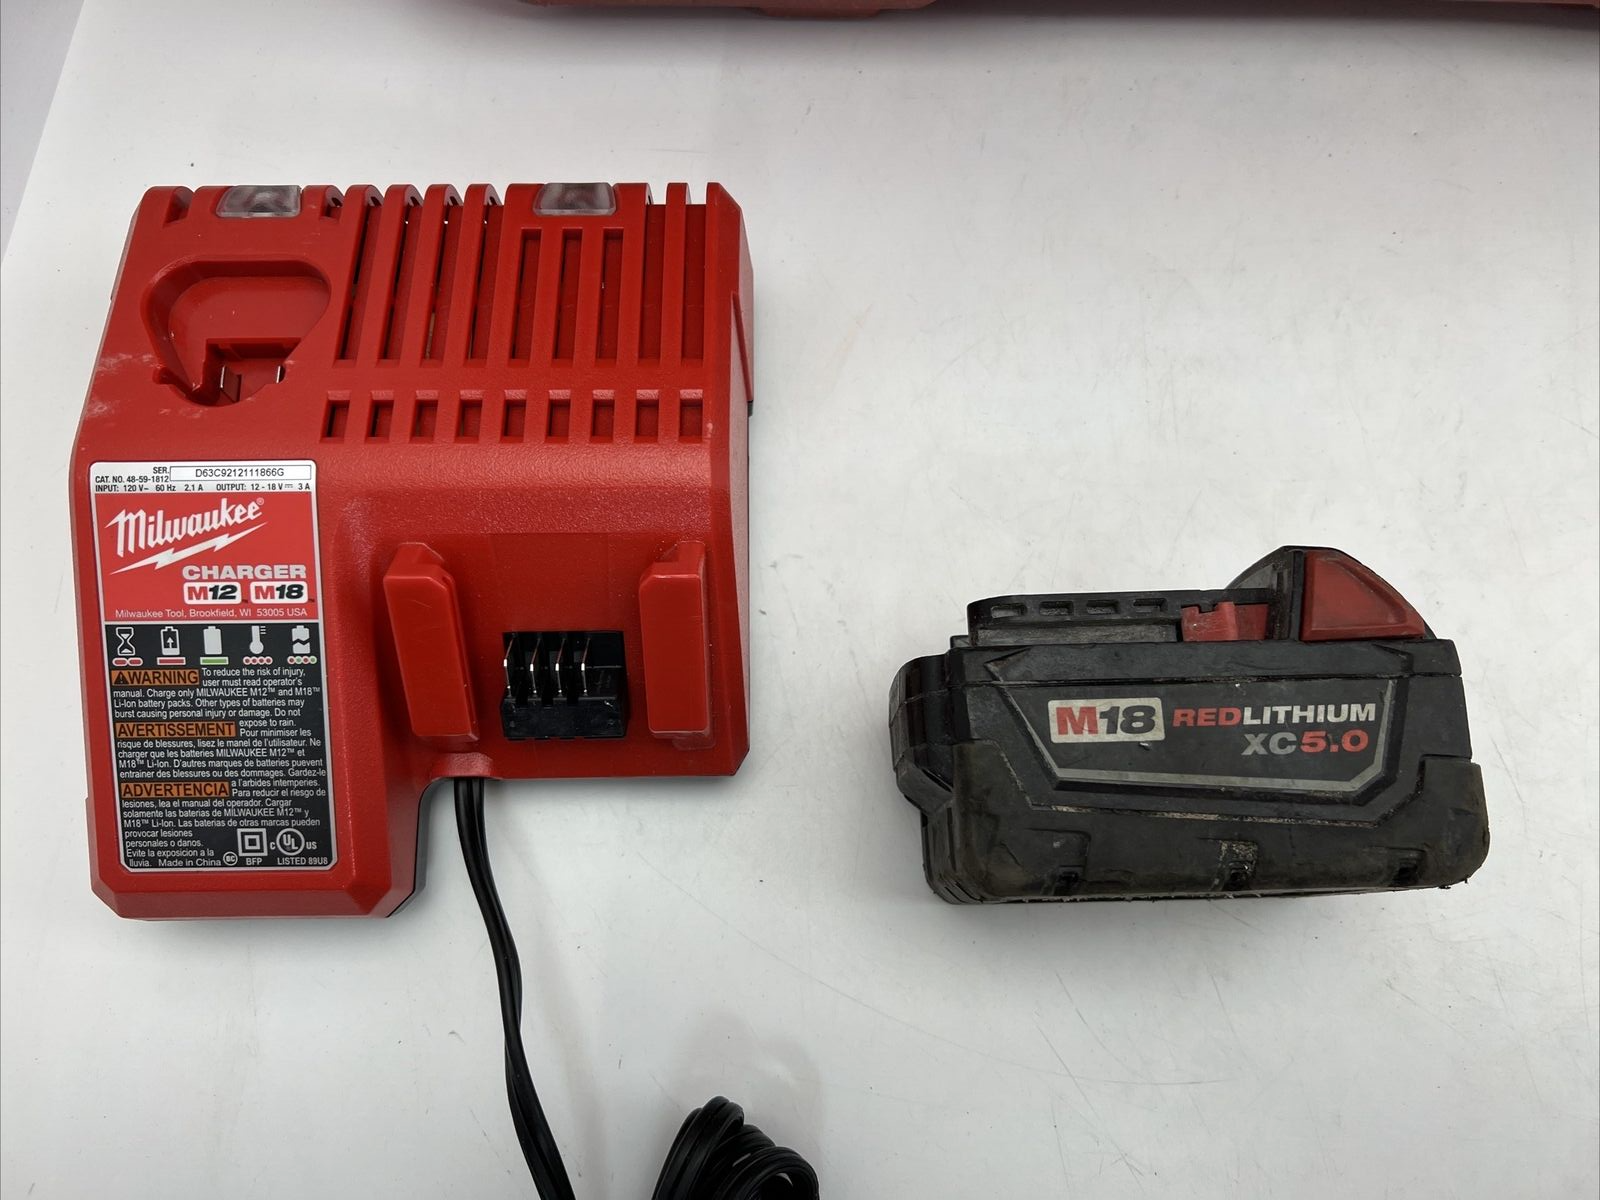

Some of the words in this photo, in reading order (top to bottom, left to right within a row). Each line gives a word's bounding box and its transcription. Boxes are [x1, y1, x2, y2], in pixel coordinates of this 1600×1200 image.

[182, 564, 306, 580] CHARGER
[164, 610, 187, 618] Tool,
[189, 608, 238, 618] Brookfield,
[240, 608, 252, 616] WI
[287, 608, 308, 616] USA
[128, 670, 198, 684] WARNING
[202, 668, 212, 676] To
[214, 668, 240, 676] reduce
[242, 668, 254, 676] the
[257, 668, 271, 676] risk
[273, 667, 280, 676] of
[282, 668, 306, 677] injury,
[243, 678, 261, 686] read
[113, 688, 144, 698] manual.
[146, 688, 176, 699] Charge
[178, 688, 194, 698] only
[196, 688, 248, 697] MILWAUKEE
[278, 688, 292, 696] and
[114, 699, 136, 708] Li-Ion
[138, 699, 166, 709] battery
[168, 698, 193, 709] packs.
[195, 698, 218, 707] Other
[220, 698, 240, 708] types
[242, 698, 251, 706] of
[252, 698, 286, 706] batteries
[288, 699, 304, 708] may
[114, 710, 135, 718] burst
[136, 710, 168, 720] causing
[169, 709, 204, 720] personal
[205, 709, 226, 718] injury
[238, 708, 272, 718] damage.
[274, 708, 286, 716] Do
[239, 720, 268, 728] expose
[279, 718, 296, 726] rain.
[1055, 705, 1156, 736] M18
[118, 723, 234, 736] AVERTISSEMENT
[240, 728, 258, 737] Pour
[260, 728, 298, 736] minimiser
[300, 728, 312, 736] les
[118, 740, 142, 750] risque
[144, 740, 154, 748] de
[156, 740, 196, 748] blessures,
[197, 739, 215, 747] lisez
[217, 738, 224, 747] le
[226, 739, 250, 747] manel
[252, 738, 262, 746] de
[309, 738, 322, 746] Ne
[118, 750, 148, 760] charger
[150, 751, 165, 760] que
[166, 750, 178, 758] les
[180, 749, 214, 758] batteries
[216, 748, 268, 757] MILWAUKEE
[297, 748, 306, 756] et
[208, 760, 242, 768] marques
[244, 758, 254, 767] de
[256, 758, 290, 767] batteries
[292, 758, 323, 768] puevent
[156, 770, 171, 778] des
[172, 769, 210, 778] blessures
[224, 769, 238, 778] des
[240, 768, 286, 778] dommages.
[288, 768, 326, 776] Gardez-le
[123, 783, 228, 796] ADVERTENCIA
[232, 788, 250, 797] Para
[252, 788, 280, 796] reducir
[281, 788, 288, 796] el
[290, 788, 314, 798] riesgo
[316, 788, 326, 796] de
[122, 800, 156, 808] lesiones,
[158, 800, 170, 808] lea
[172, 800, 180, 808] el
[182, 800, 210, 808] manual
[212, 799, 224, 808] del
[226, 798, 264, 808] operador.
[265, 798, 292, 808] Cargar
[123, 810, 164, 818] solamente
[166, 809, 177, 818] las
[212, 808, 222, 816] de
[224, 808, 274, 817] MILWAUKEE
[304, 810, 310, 818] y
[178, 819, 192, 828] Las
[227, 818, 238, 826] de
[292, 818, 320, 828] pueden
[124, 830, 159, 840] provocar
[160, 829, 193, 838] lesiones
[126, 840, 168, 849] personales
[306, 841, 317, 850] US
[126, 849, 146, 858] Evite
[148, 849, 155, 857] la
[206, 848, 214, 856] la
[130, 858, 152, 867] lluvia.
[158, 858, 184, 866] Made
[196, 858, 222, 866] China
[246, 858, 262, 866] BFP
[278, 857, 306, 865] LISTED
